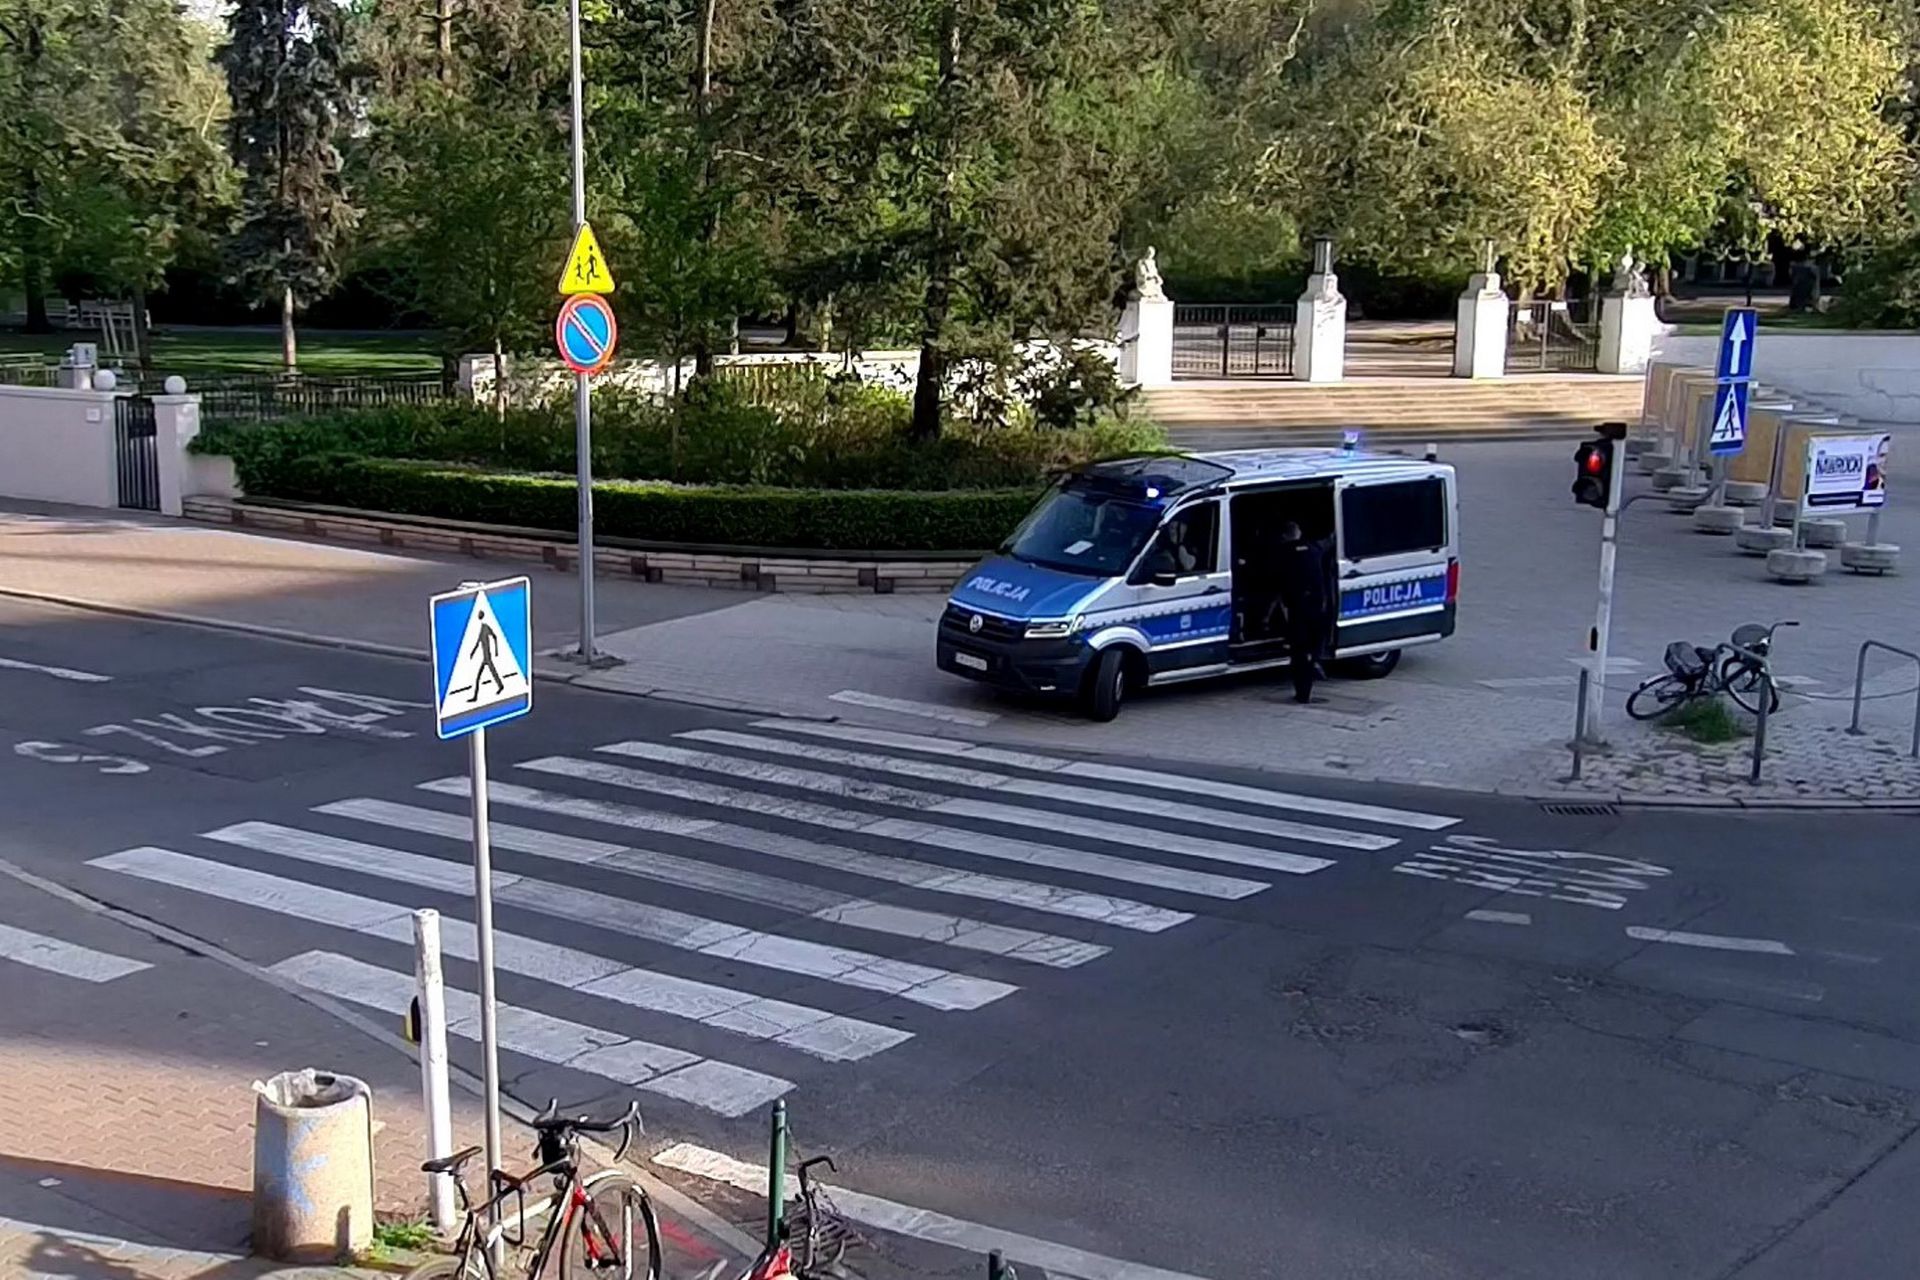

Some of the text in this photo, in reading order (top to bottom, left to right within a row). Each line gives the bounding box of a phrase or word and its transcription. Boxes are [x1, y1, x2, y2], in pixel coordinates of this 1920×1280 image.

[967, 576, 1030, 602] POLICJA
[1363, 581, 1422, 606] POLICJA
[1392, 834, 1673, 910] BUS
